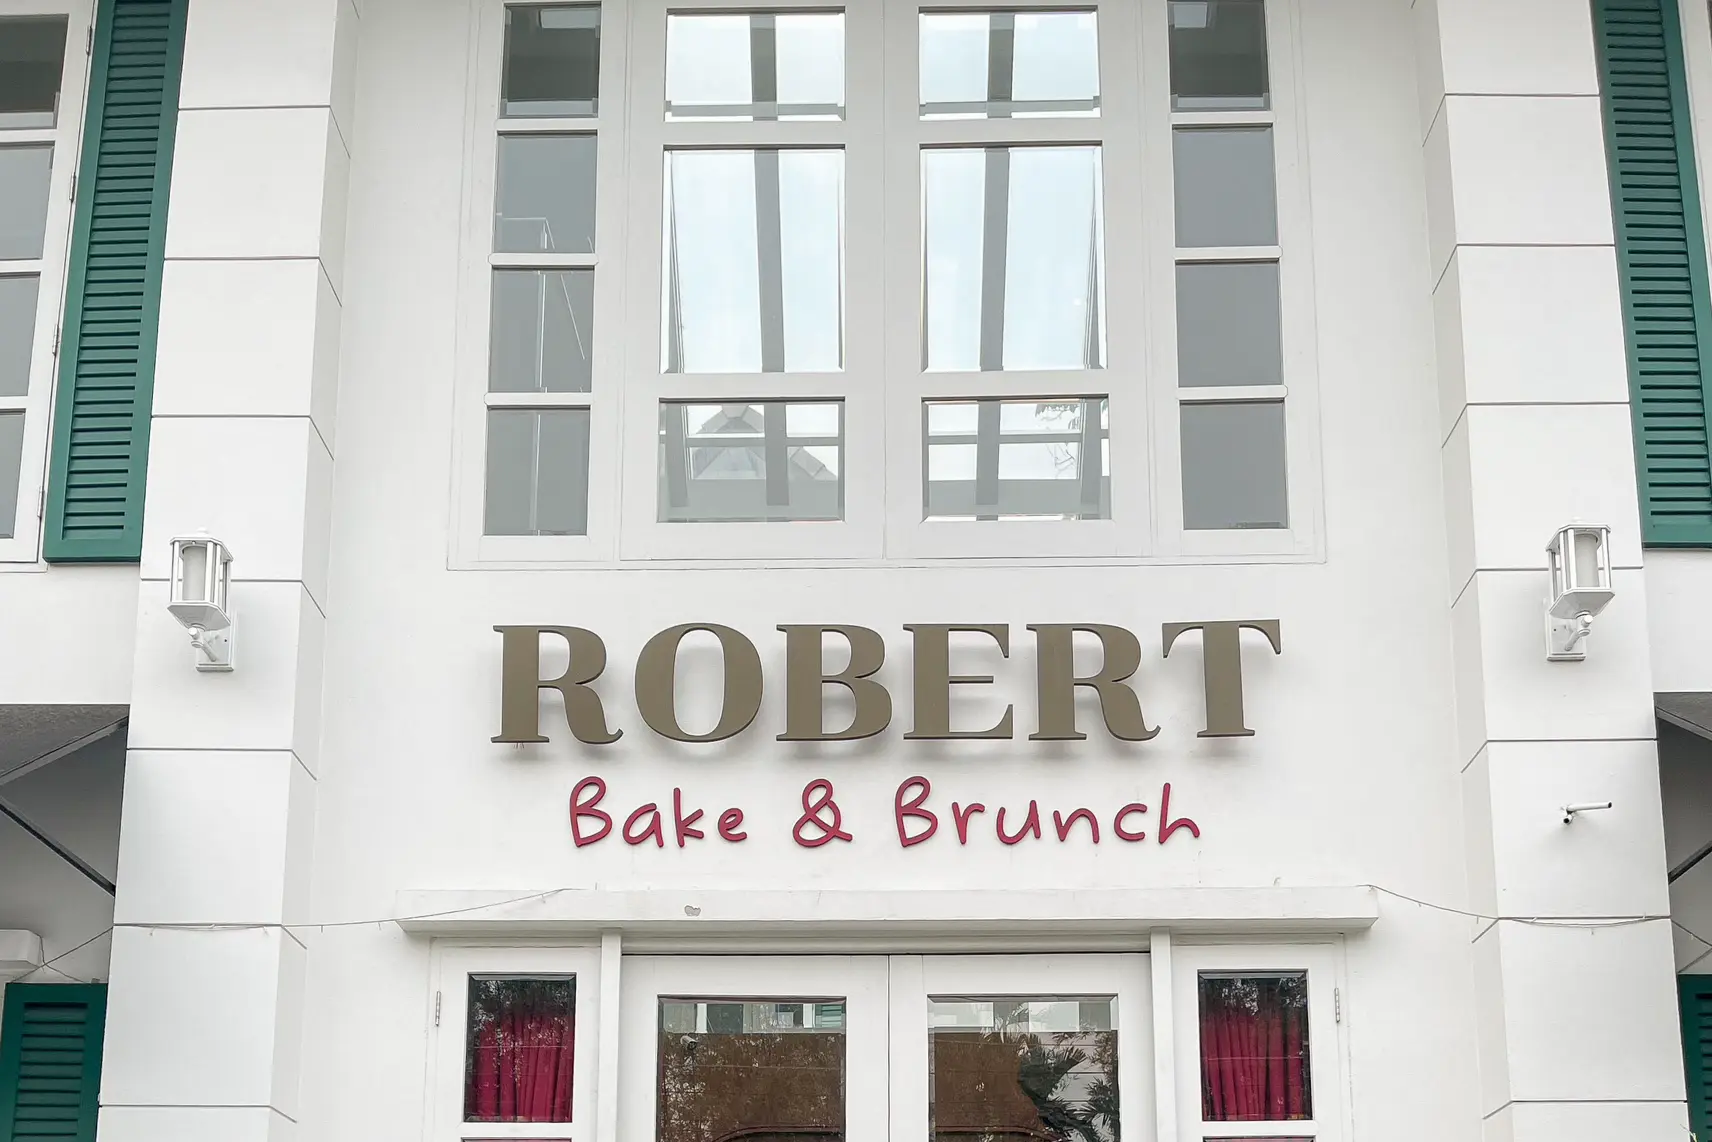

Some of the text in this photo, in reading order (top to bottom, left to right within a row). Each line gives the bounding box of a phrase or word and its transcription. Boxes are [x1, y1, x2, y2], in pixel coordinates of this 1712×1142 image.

[490, 618, 1282, 745] ROBERT
[568, 774, 1201, 849] Bake & Brunch
